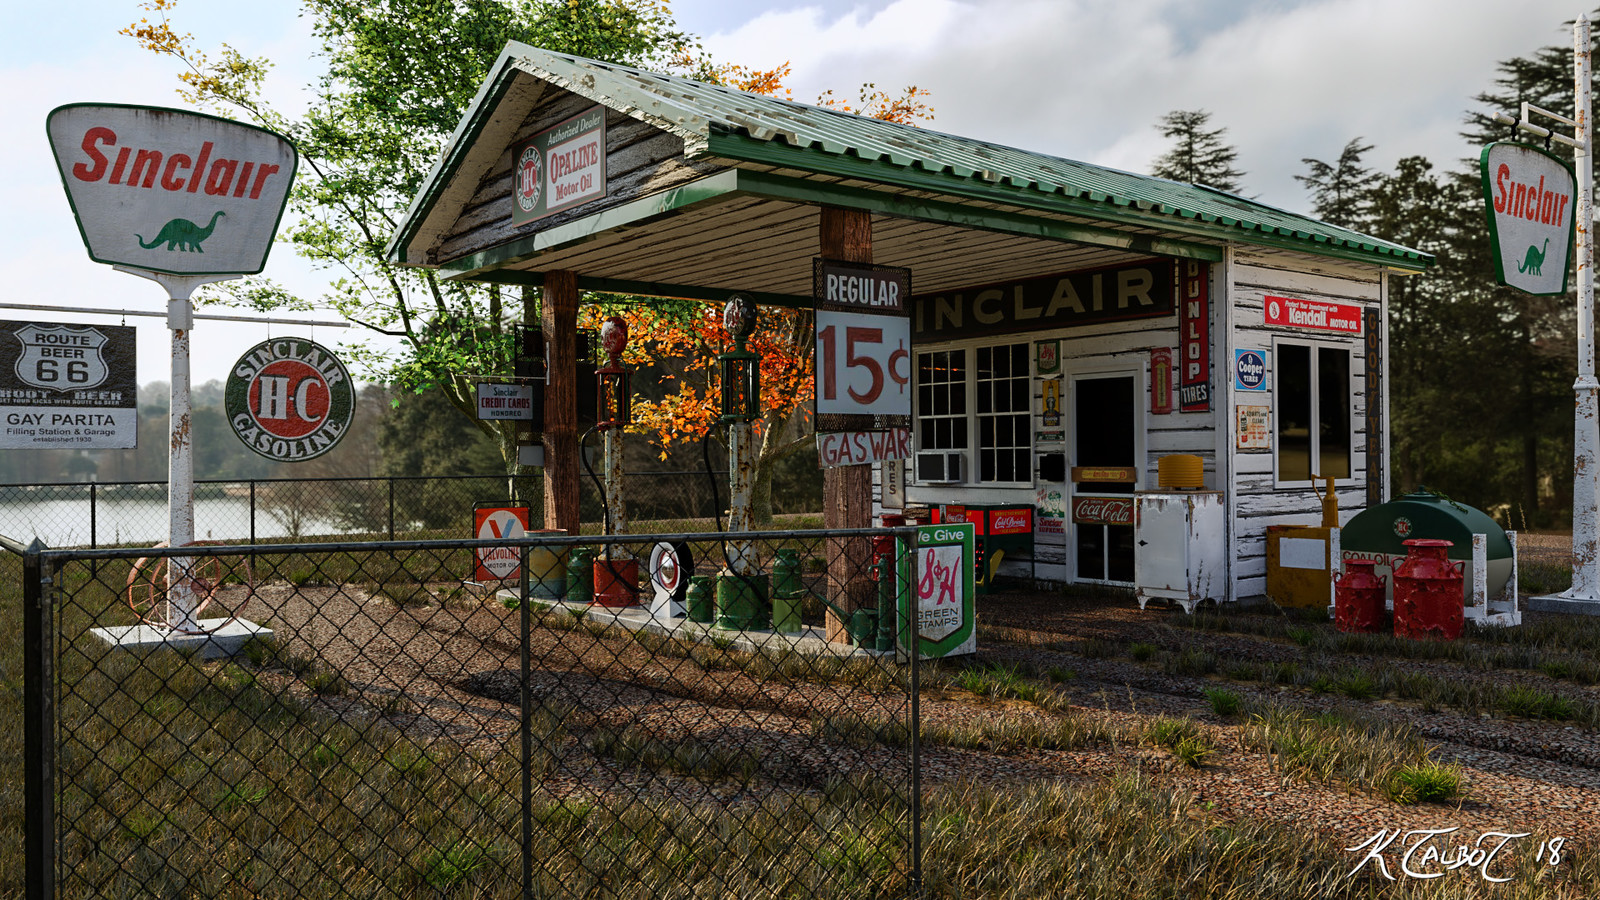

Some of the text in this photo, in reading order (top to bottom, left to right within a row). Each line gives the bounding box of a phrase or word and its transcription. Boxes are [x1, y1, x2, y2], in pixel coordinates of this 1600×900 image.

[548, 113, 600, 146] Authorized Dealer
[72, 126, 279, 200] Sinclair
[550, 141, 598, 184] OPALINE
[556, 173, 592, 201] Motor Oil
[1493, 163, 1568, 227] Sinclair
[826, 273, 898, 307] REGULAR
[915, 267, 1154, 333] INCLAIR
[1285, 300, 1299, 309] Protect
[1300, 301, 1308, 309] Your
[1187, 260, 1200, 380] DUNLOP
[1289, 307, 1327, 327] Kendall
[1330, 318, 1357, 330] MOTOR OIL
[35, 333, 90, 345] ROUTE
[41, 347, 84, 359] BEER
[36, 360, 88, 383] 66
[236, 341, 343, 387] SINCLAIR
[1238, 361, 1263, 376] Cooper
[1243, 375, 1258, 383] TIRES
[74, 390, 122, 400] BEER
[493, 387, 518, 396] Sinclair
[1182, 384, 1207, 404] TIRES
[481, 398, 530, 408] CREDIT CARDS
[7, 413, 116, 426] GAY PARITA
[7, 428, 35, 436] Filling
[84, 428, 116, 436] Garage
[234, 413, 343, 457] GASOLINE
[888, 461, 896, 495] RES
[1076, 499, 1132, 522] Coca-Cola
[1039, 517, 1063, 527] Sinclair
[934, 529, 964, 541] Give
[482, 546, 521, 562] VALVOLINE
[917, 608, 959, 619] GREEN
[917, 617, 959, 629] STAMPS
